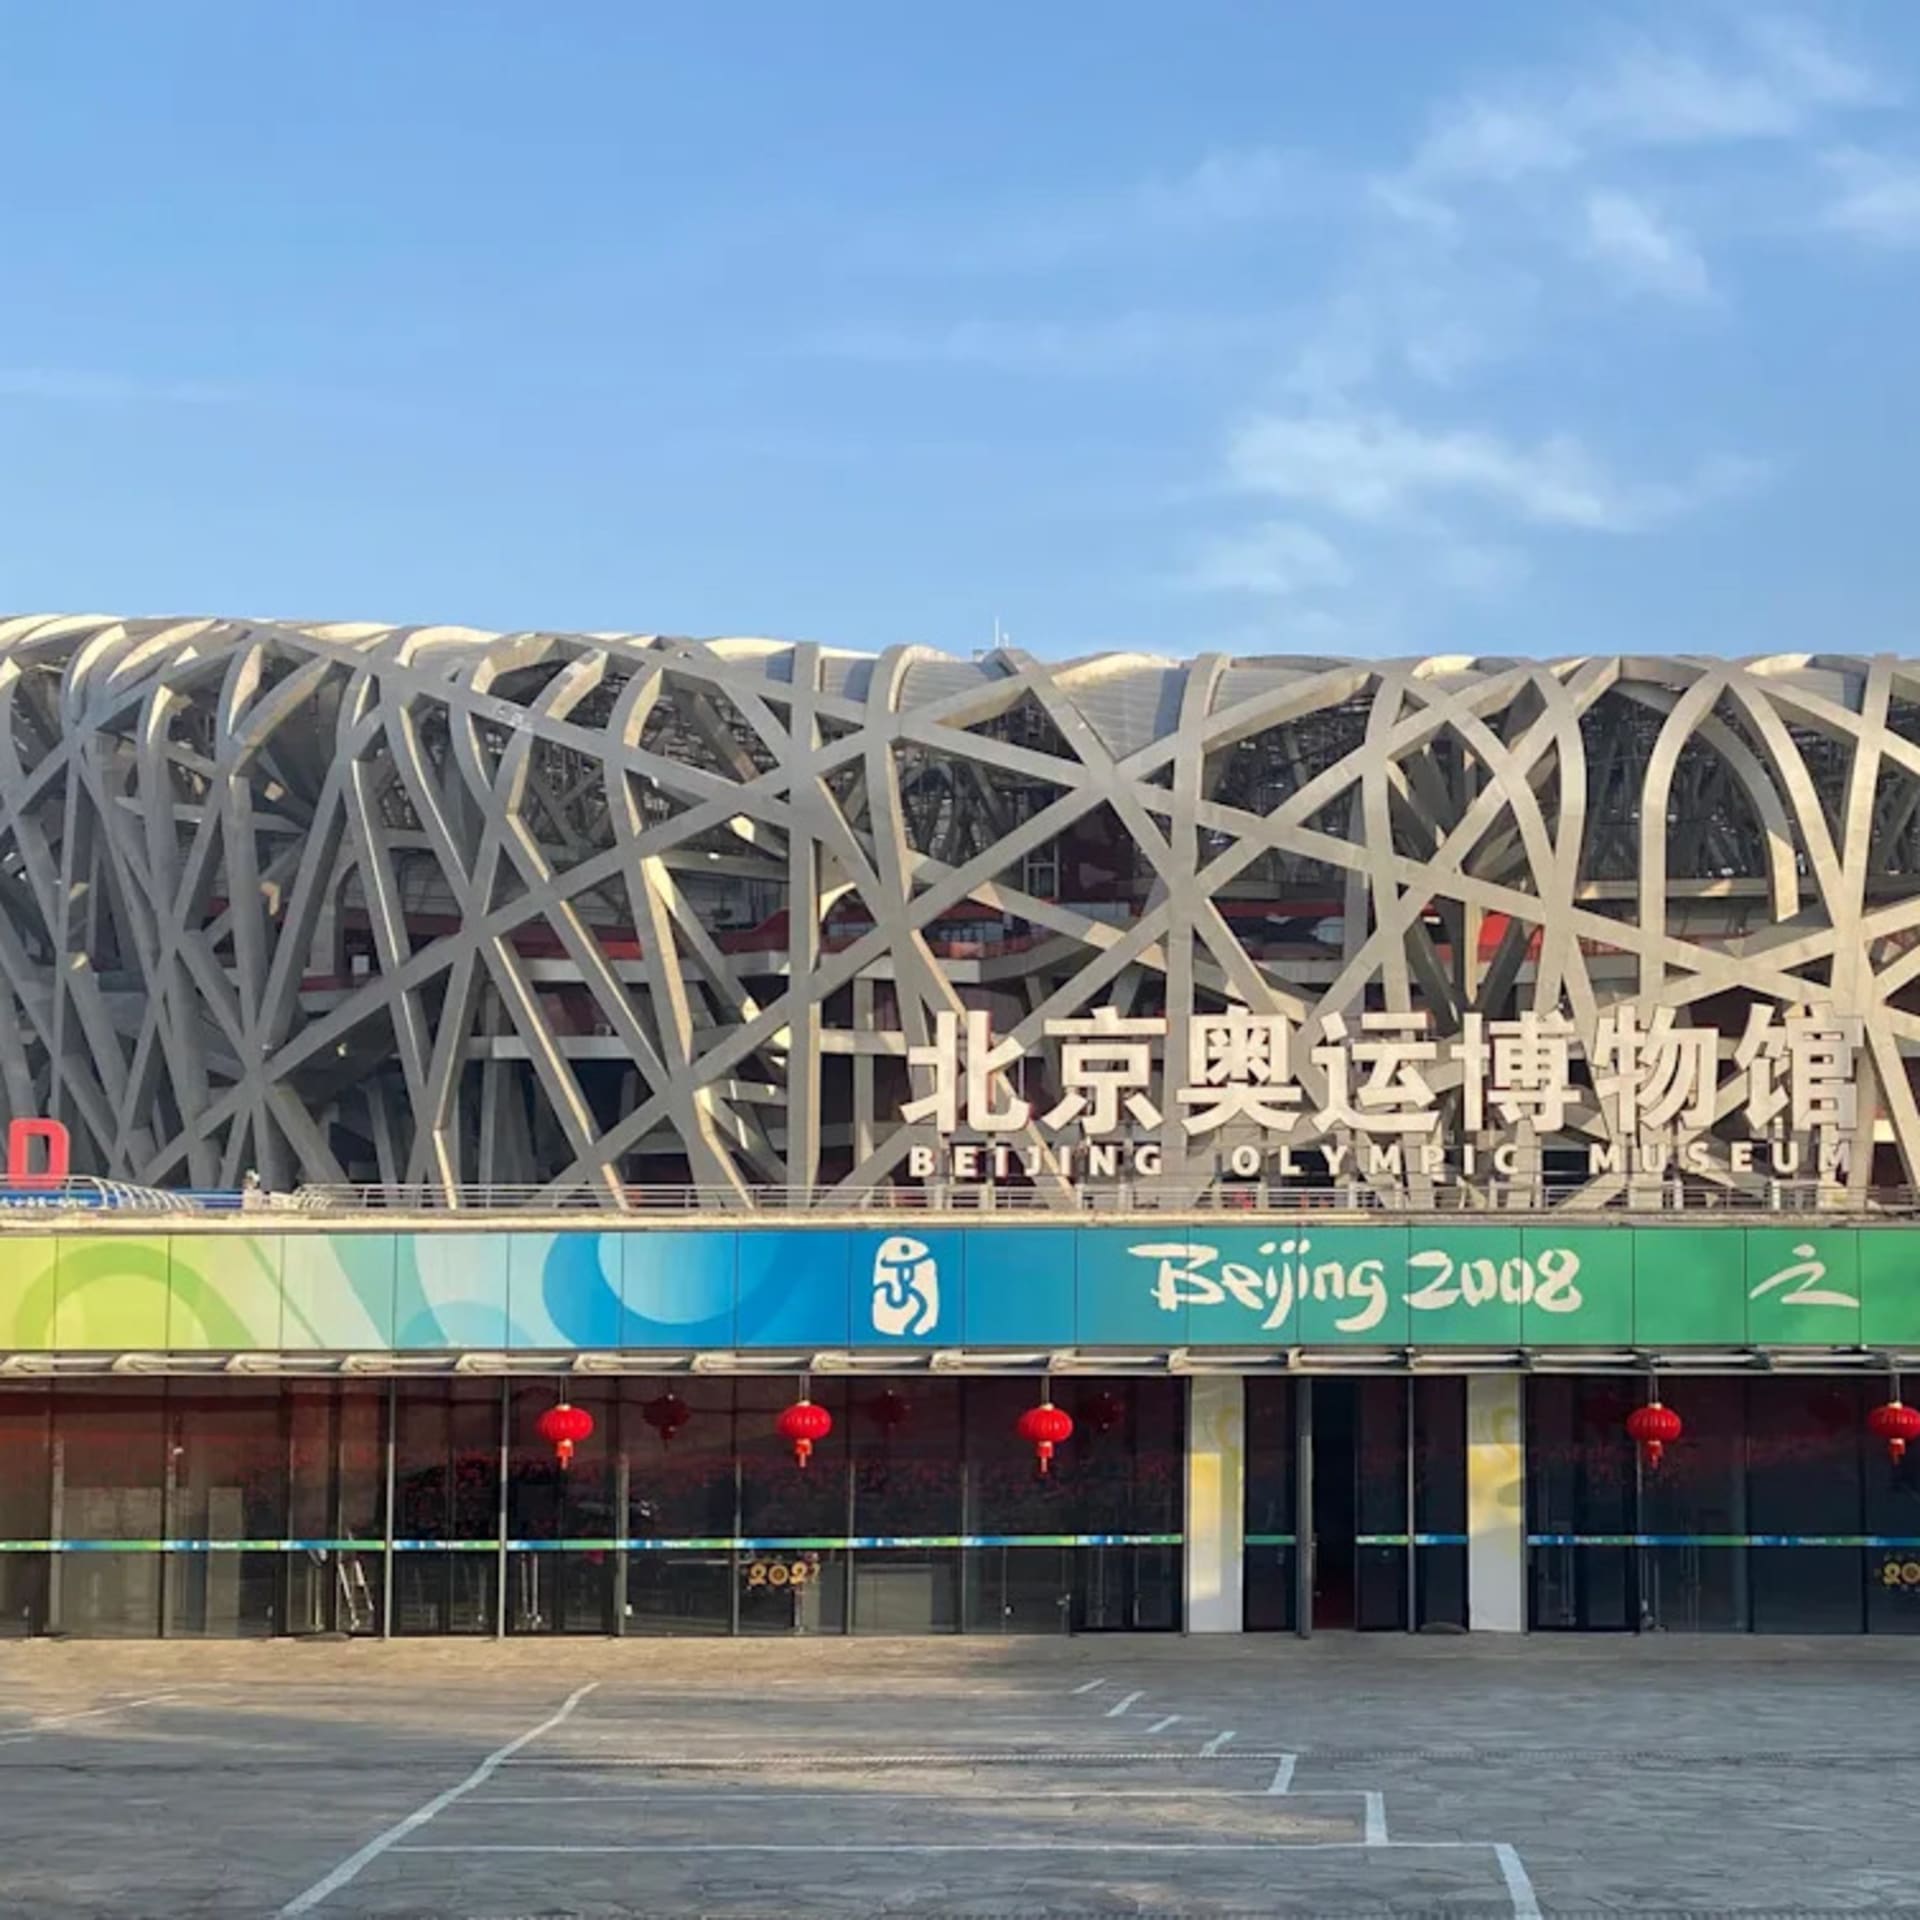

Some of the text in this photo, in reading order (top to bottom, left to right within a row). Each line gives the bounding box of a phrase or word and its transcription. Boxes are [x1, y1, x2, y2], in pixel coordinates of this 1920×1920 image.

[900, 1002, 1864, 1135] 北京奥运博物馆
[8, 1118, 69, 1189] D
[909, 1142, 1852, 1177] BEIJING OLYMPIC MUSEUM
[1128, 1239, 1584, 1332] Beijing 2008
